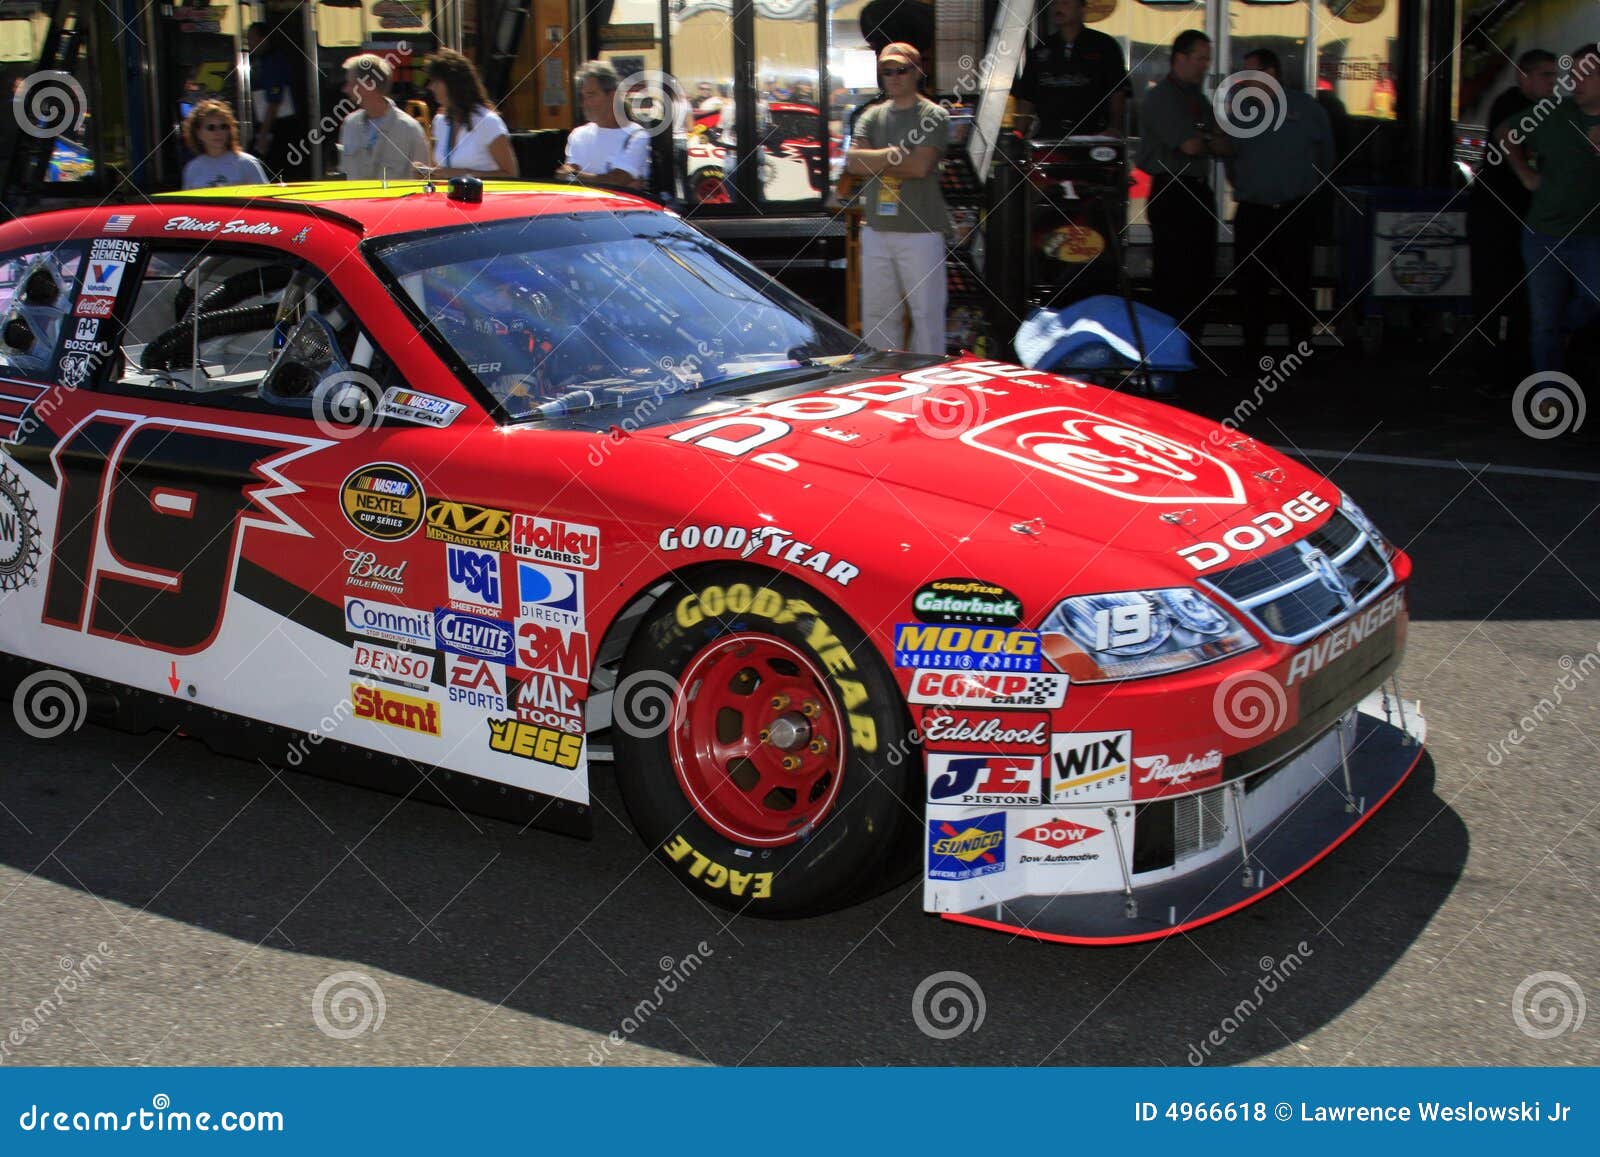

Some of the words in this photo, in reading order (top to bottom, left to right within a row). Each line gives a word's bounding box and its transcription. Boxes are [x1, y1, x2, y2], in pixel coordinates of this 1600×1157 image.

[1059, 179, 1080, 199] 1
[163, 215, 221, 233] Elliott
[220, 219, 282, 236] Sadler
[89, 249, 137, 264] SIEMENS
[92, 238, 141, 253] SIEMENS
[64, 339, 102, 352] BOSCH
[381, 404, 412, 417] RACE
[413, 411, 444, 424] CAR
[406, 394, 450, 414] NASCAR
[668, 360, 1048, 457] DODGE
[373, 478, 408, 496] NASCAR
[356, 493, 407, 515] NEXTEL
[42, 409, 305, 656] 19
[360, 513, 375, 523] CUP
[377, 516, 403, 528] SERIES
[1176, 490, 1331, 571] DODGE
[426, 525, 479, 548] MECHANIX
[479, 539, 510, 552] WEAR
[514, 514, 599, 566] Holley
[343, 548, 409, 582] Bud
[514, 544, 534, 556] HP
[534, 548, 582, 565] CARBS
[658, 524, 861, 587] GOODYEAR
[449, 547, 500, 605] USG
[932, 582, 1004, 595] GOODYEAR
[346, 599, 432, 638] Commit
[450, 601, 500, 618] SHEETROCK
[521, 604, 581, 627] DIRECTV
[943, 614, 994, 623] BELTS
[366, 629, 381, 638] STOP
[441, 613, 508, 652] CLEVITE
[1094, 602, 1152, 652] 19
[517, 622, 588, 680] 3M
[897, 626, 1038, 656] MOOG
[354, 646, 429, 679] DENSO
[450, 655, 503, 695] EA
[675, 583, 878, 753] GOODYEAR
[901, 653, 973, 668] CHASSIS
[980, 656, 1034, 670] PARTS
[448, 687, 505, 712] SPORTS
[517, 674, 582, 718] MAC
[917, 672, 1028, 700] COMP
[991, 694, 1047, 705] CAMS
[353, 686, 438, 735] Stant
[517, 707, 583, 733] TOOLS
[488, 718, 584, 770] JEGS
[925, 715, 1048, 746] Edelbrock
[1054, 733, 1127, 780] WIX
[929, 757, 1036, 800] JE
[1053, 773, 1127, 801] FILTERS
[961, 794, 1040, 805] PISTONS
[935, 830, 1002, 855] SUNOCO
[662, 834, 774, 899] EAGLE
[1019, 851, 1041, 864] Dow
[1043, 851, 1100, 863] Automotive
